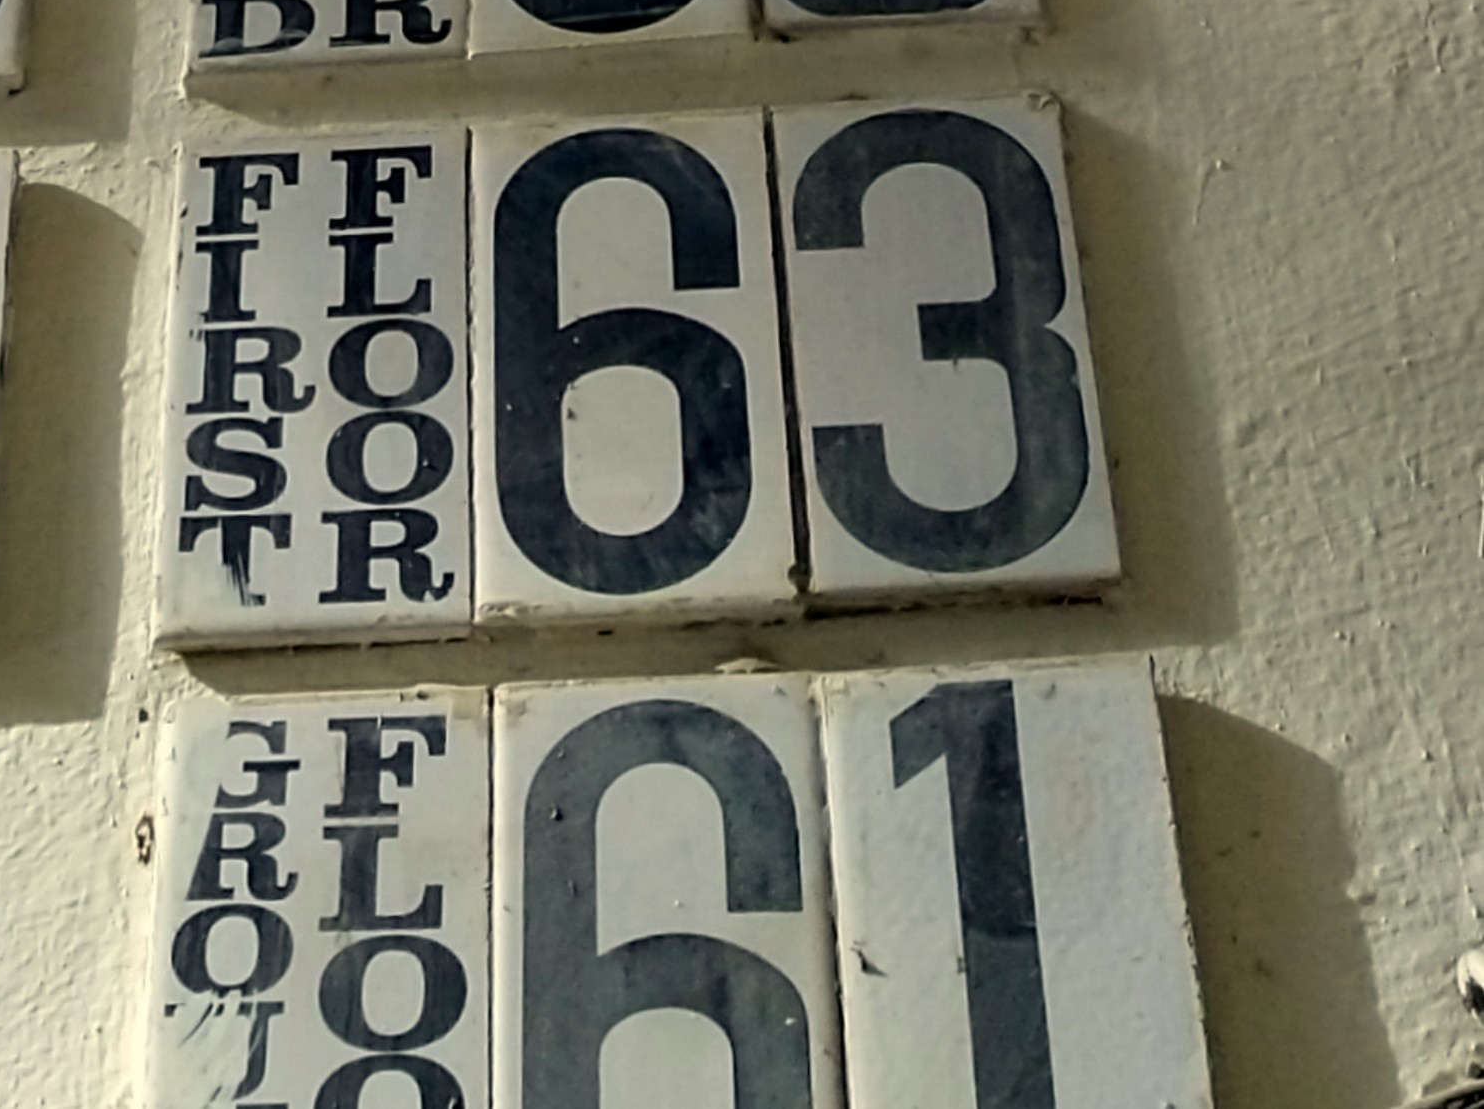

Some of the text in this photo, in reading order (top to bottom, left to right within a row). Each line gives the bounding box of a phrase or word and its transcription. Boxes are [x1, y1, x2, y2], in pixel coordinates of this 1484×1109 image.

[179, 146, 455, 605] FIRST FLOOR
[493, 109, 1090, 594] 63
[521, 679, 1052, 1109] 61
